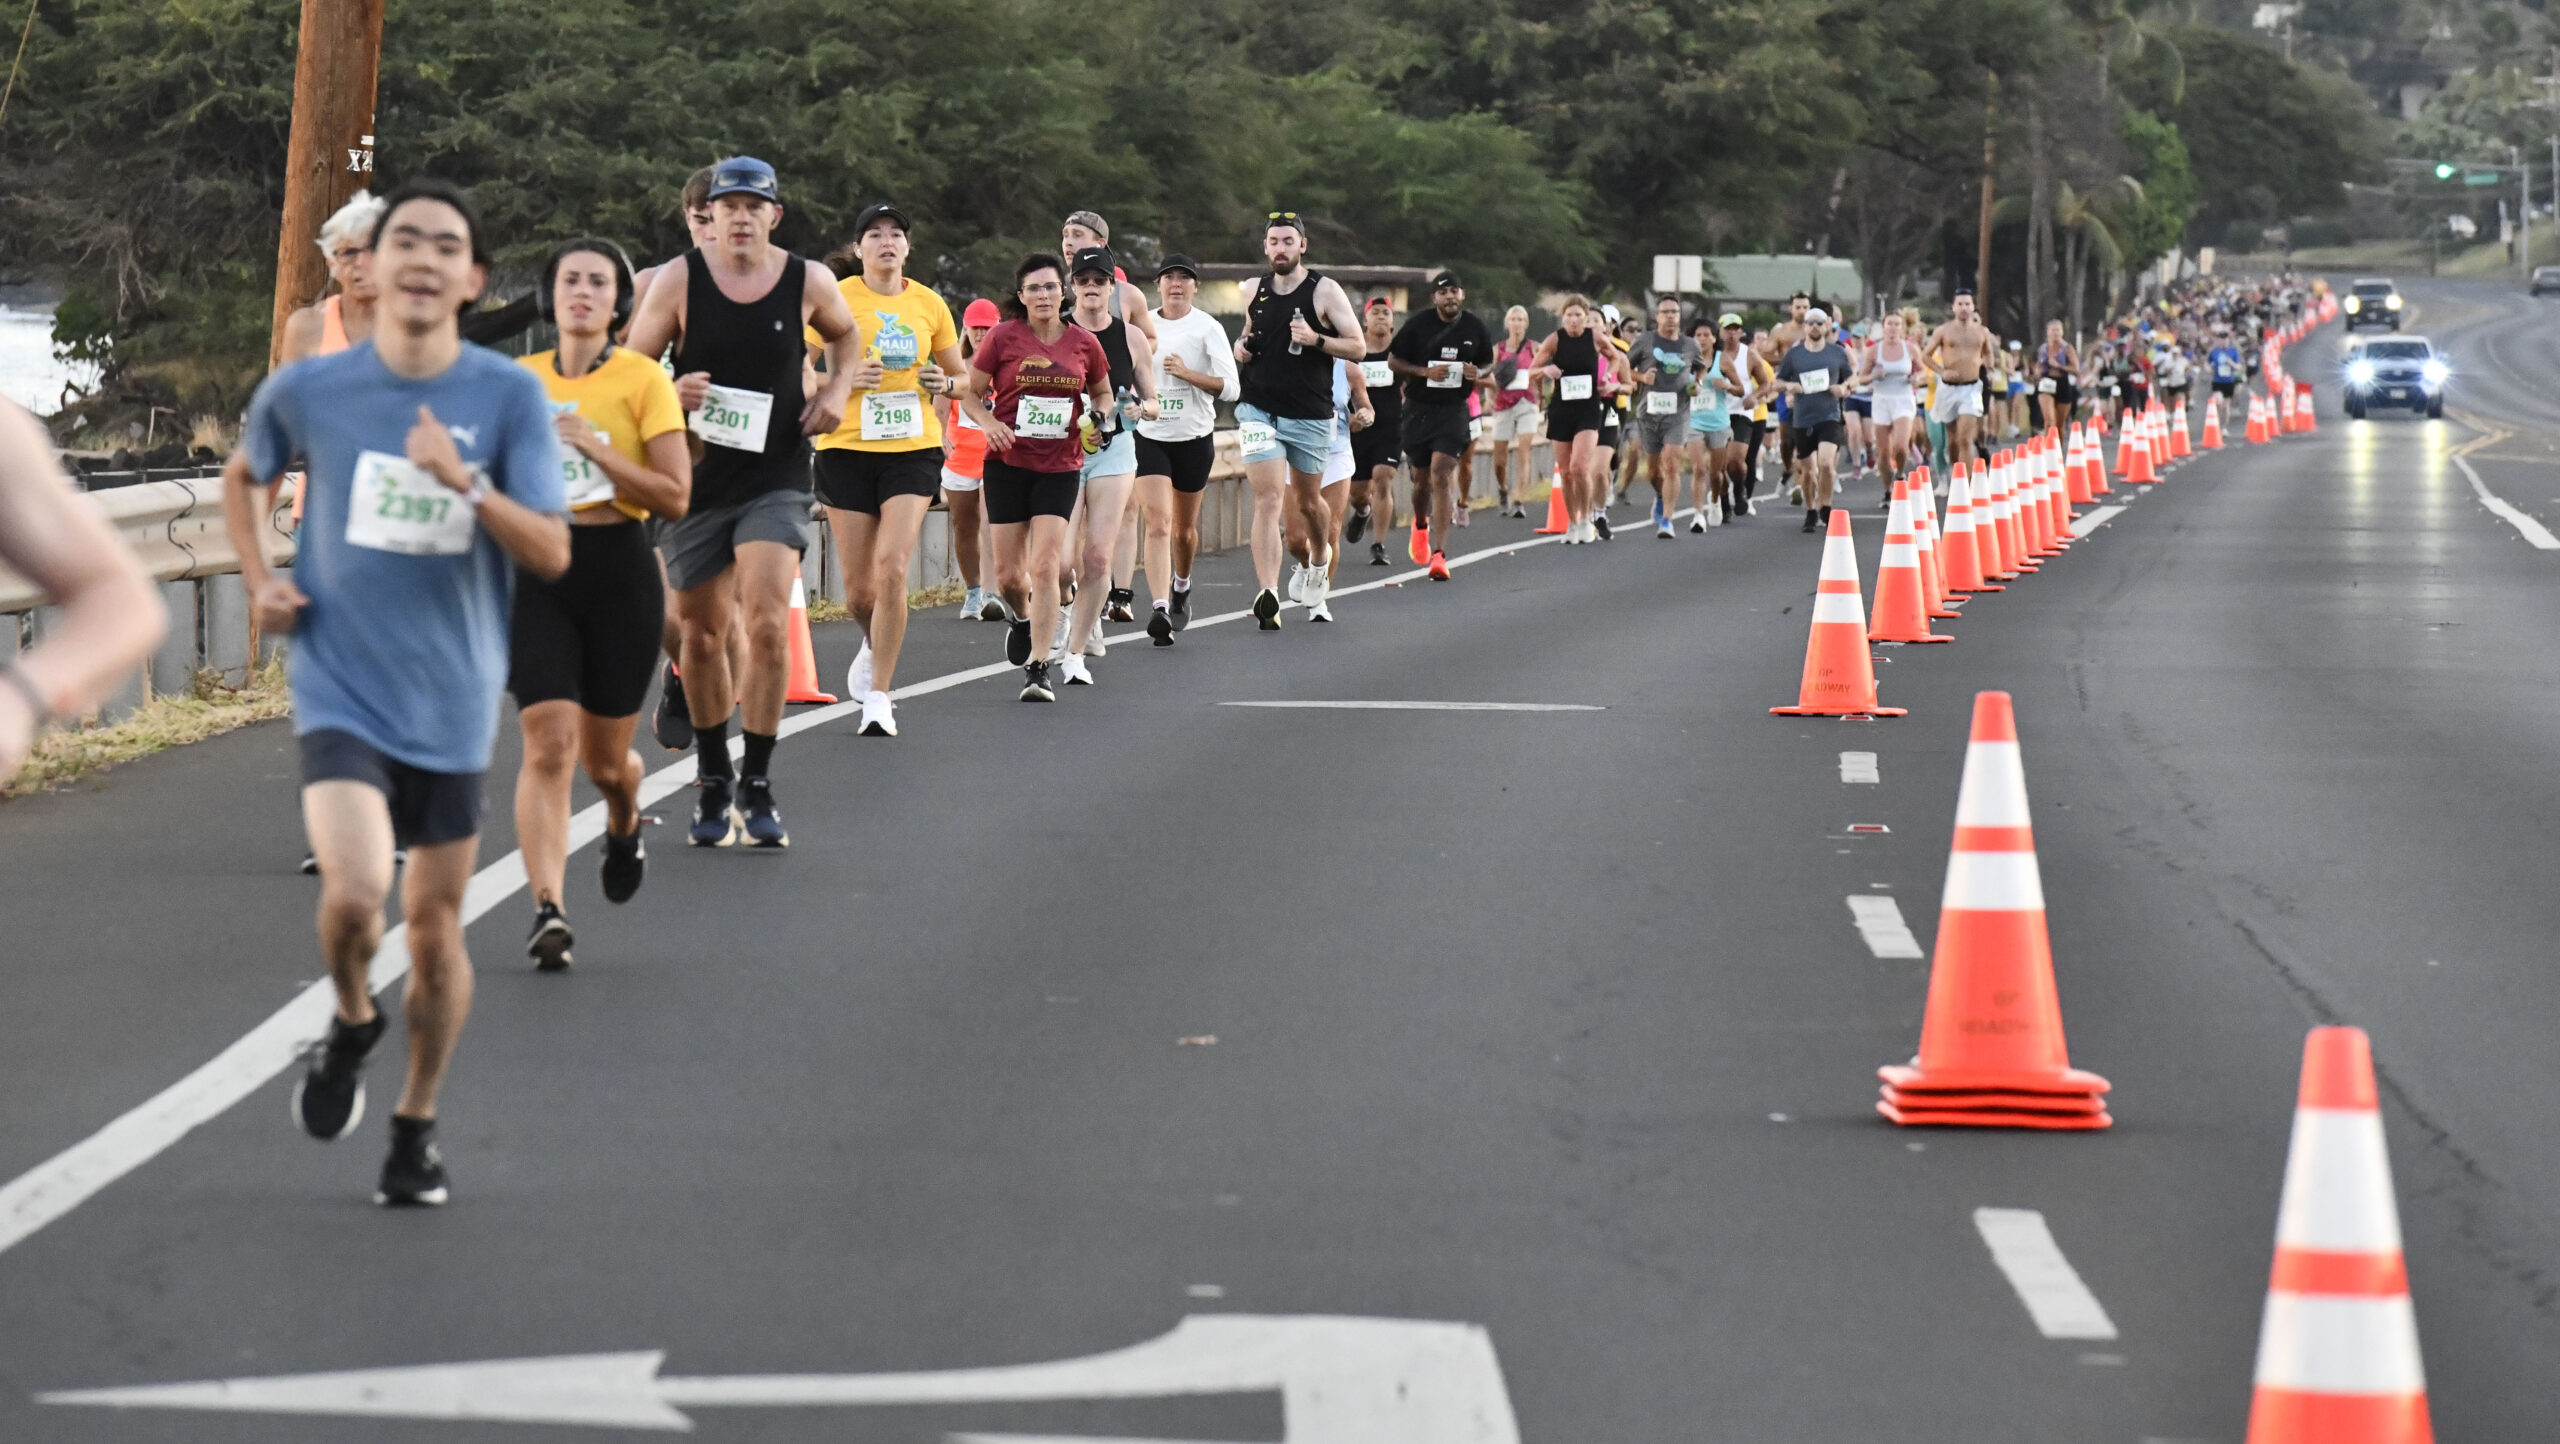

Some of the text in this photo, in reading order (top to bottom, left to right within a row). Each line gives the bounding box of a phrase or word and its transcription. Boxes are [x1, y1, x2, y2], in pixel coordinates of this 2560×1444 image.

[879, 339, 913, 350] MAUI
[1015, 375, 1080, 385] PACIFIC CREST
[702, 405, 750, 431] 2301
[874, 408, 912, 425] 2198
[1027, 411, 1063, 426] 2344
[1242, 431, 1267, 445] 2423
[376, 488, 453, 523] 2397
